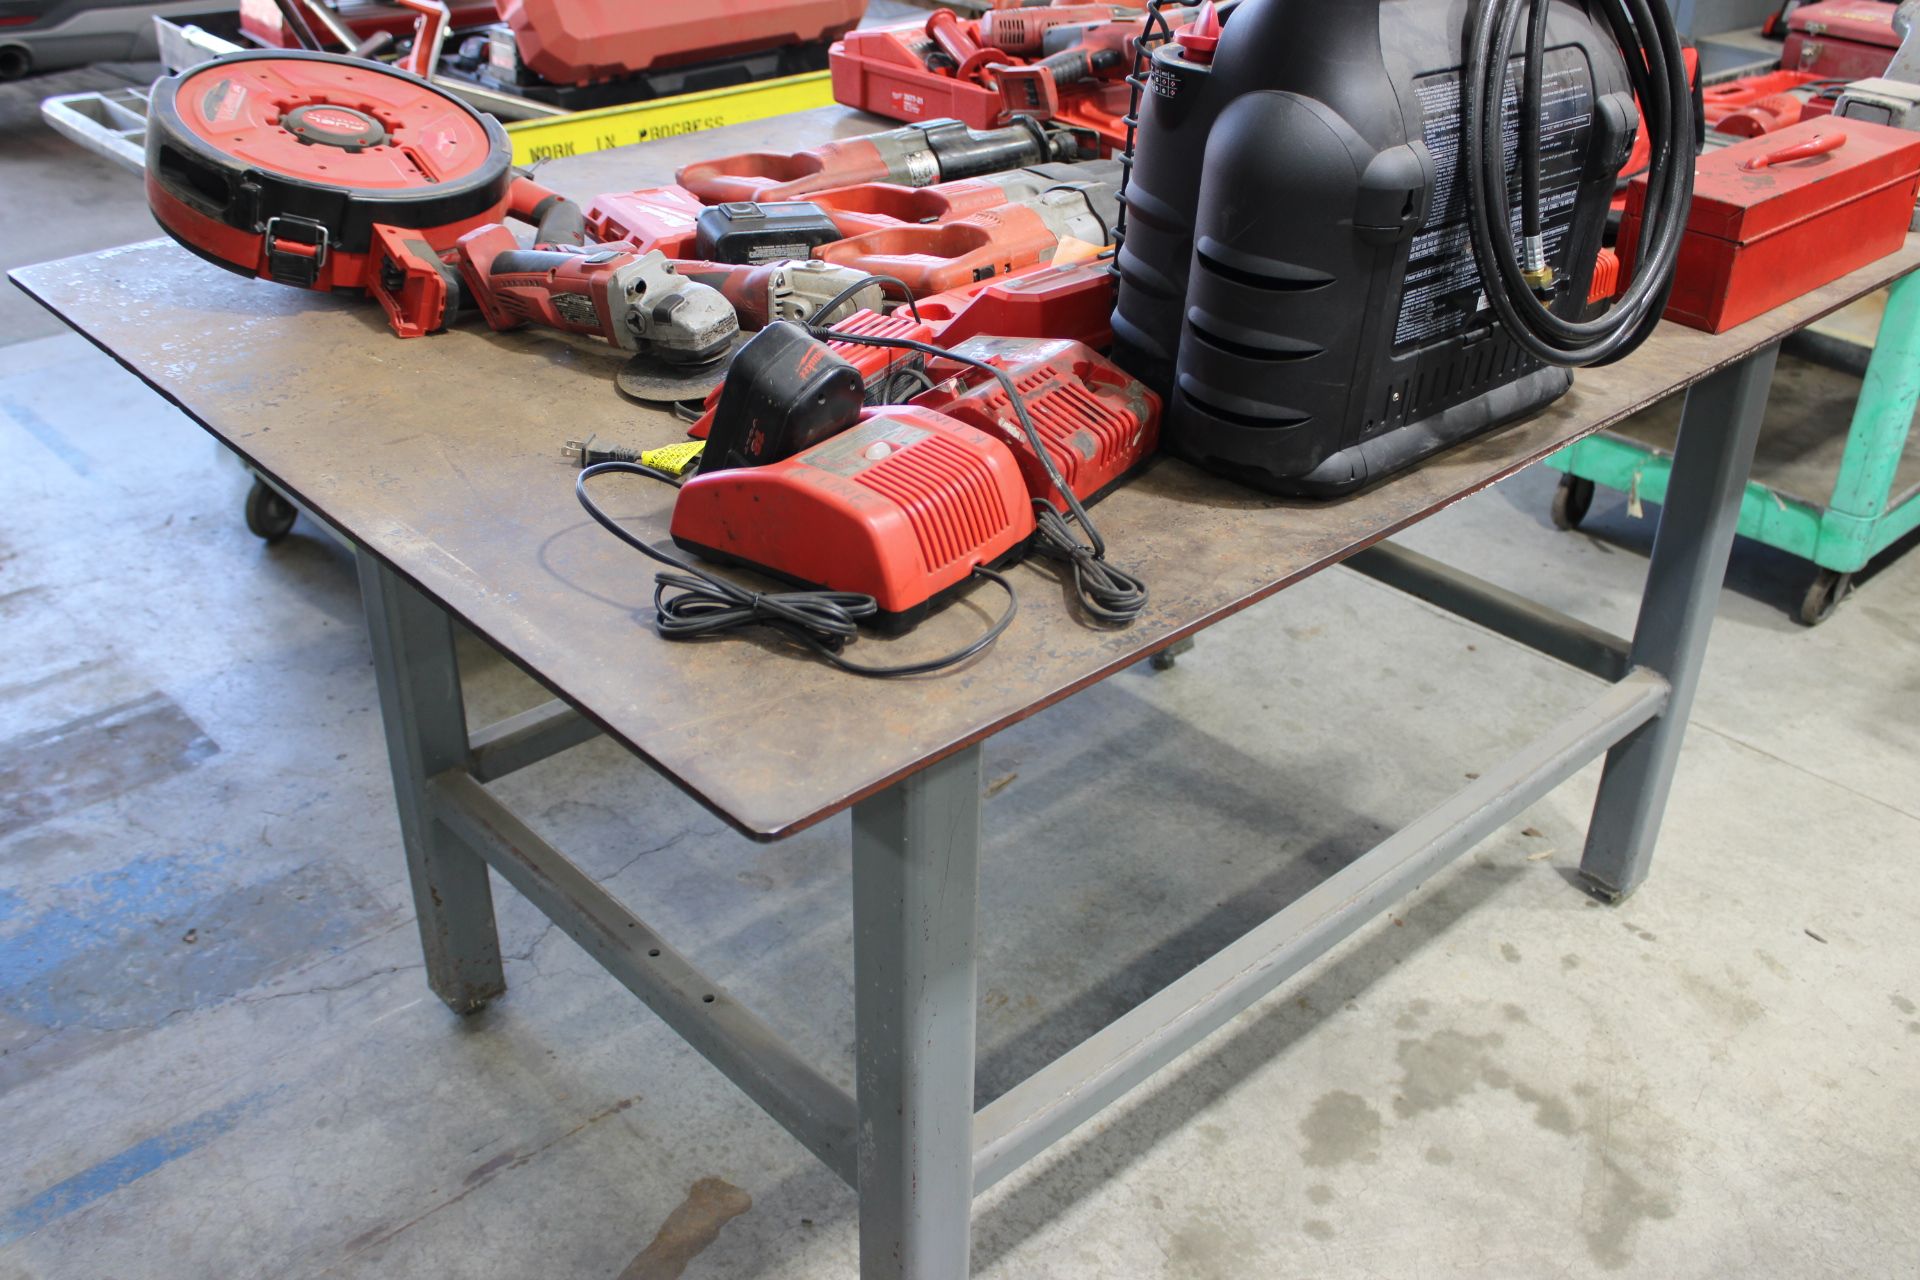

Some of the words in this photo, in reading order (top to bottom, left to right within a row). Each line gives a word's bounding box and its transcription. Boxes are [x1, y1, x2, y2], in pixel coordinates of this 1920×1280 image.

[529, 141, 576, 162] WORK
[596, 134, 617, 151] IN
[638, 116, 724, 143] PROGRESS
